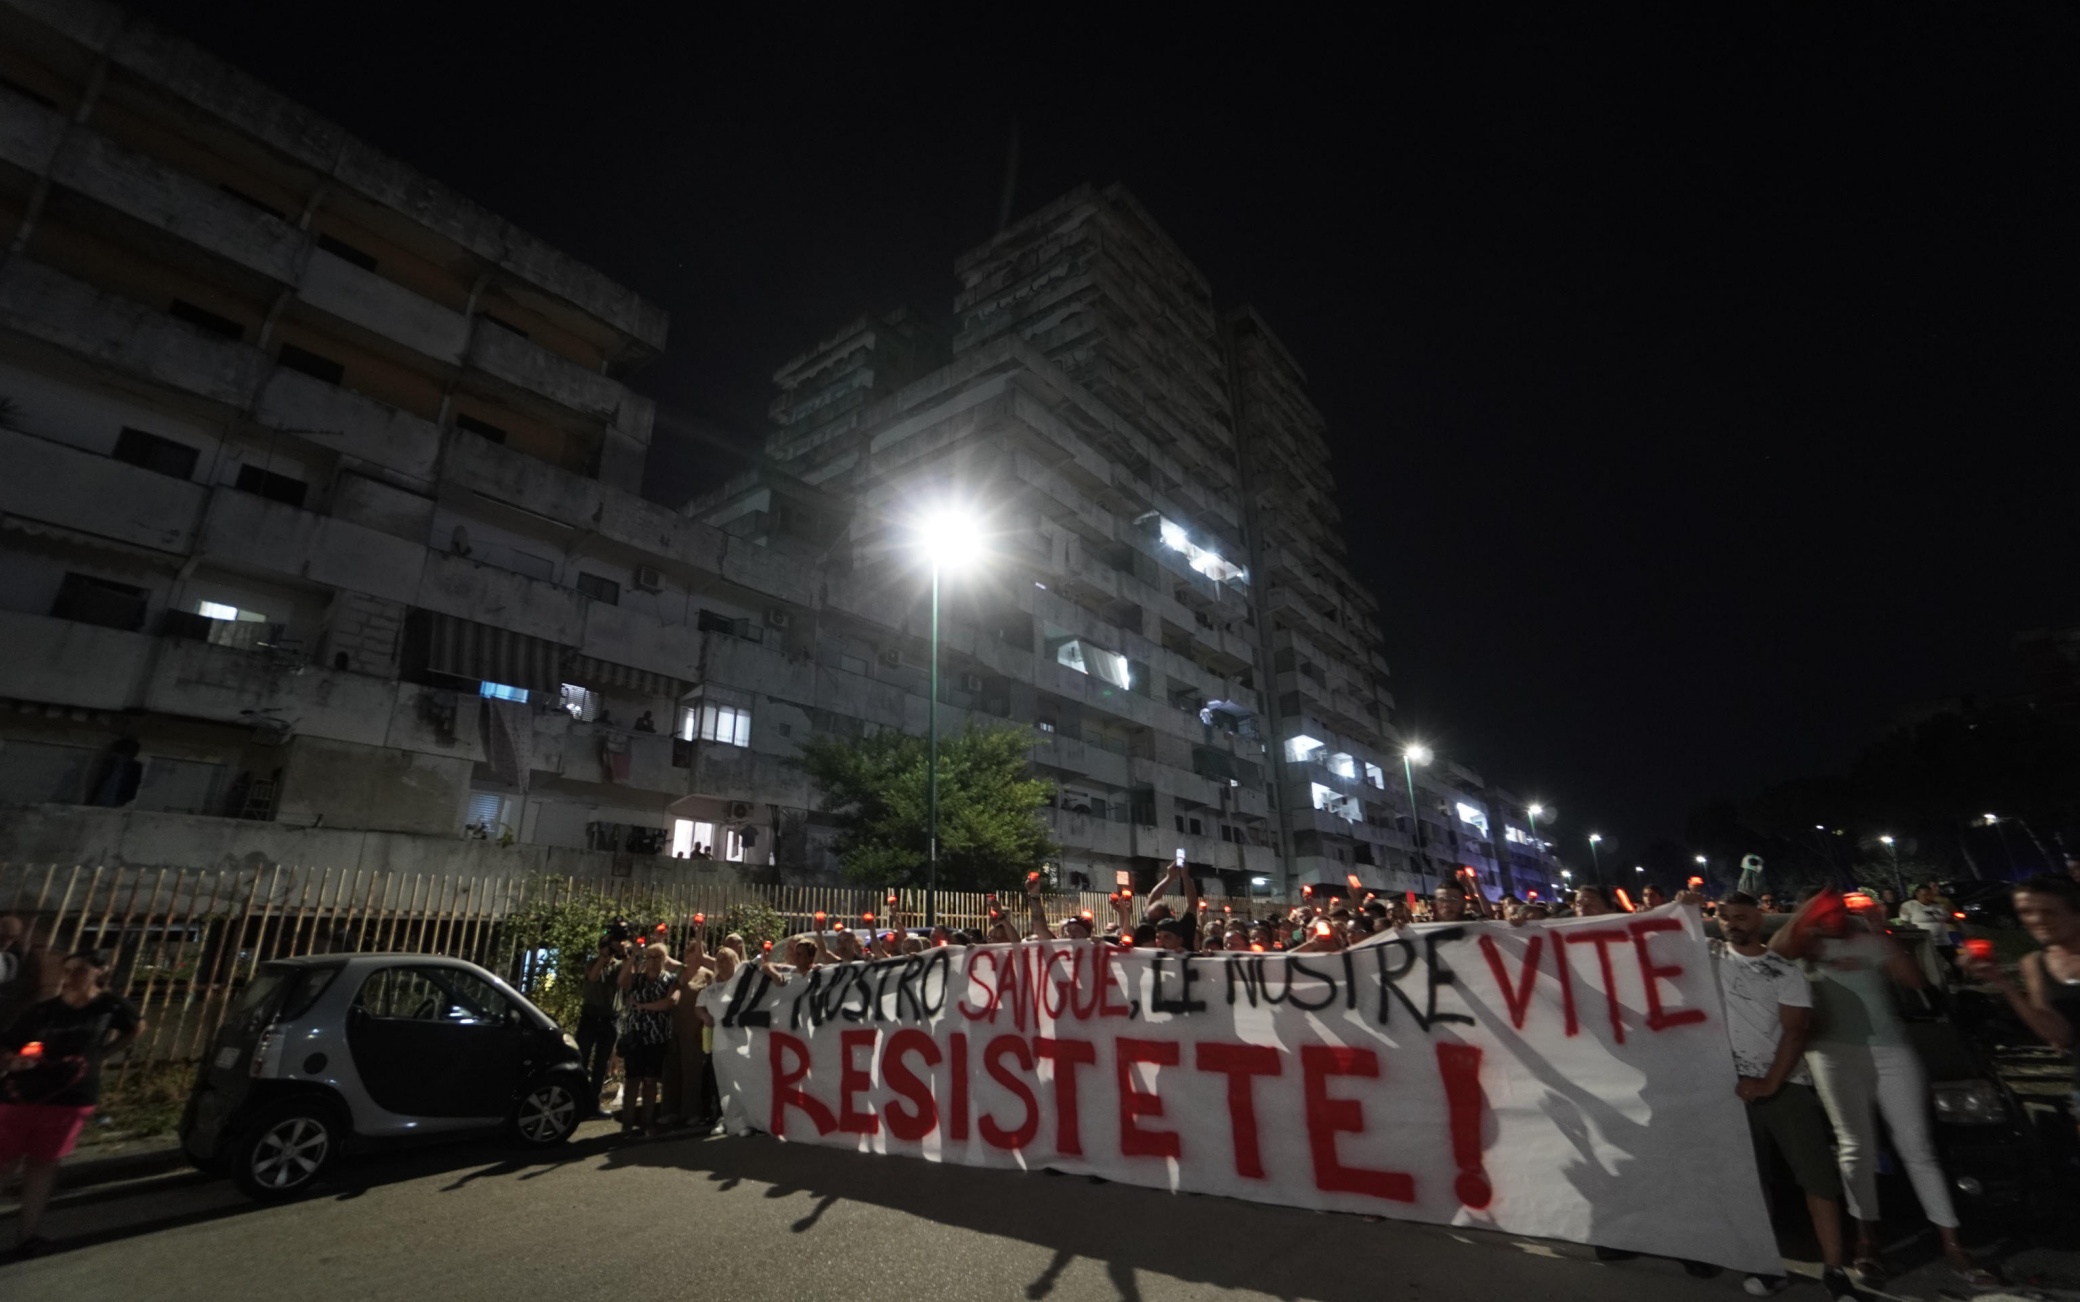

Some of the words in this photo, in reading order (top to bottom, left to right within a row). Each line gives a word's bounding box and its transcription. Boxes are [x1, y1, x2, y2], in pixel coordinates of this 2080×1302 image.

[722, 961, 772, 1028] IL
[790, 950, 949, 1030] NOSTRO
[958, 943, 1140, 1032] SANGUE,
[1152, 951, 1206, 1014] LE
[1478, 918, 1707, 1044] VITE
[769, 1028, 1493, 1210] RESISTETE!
